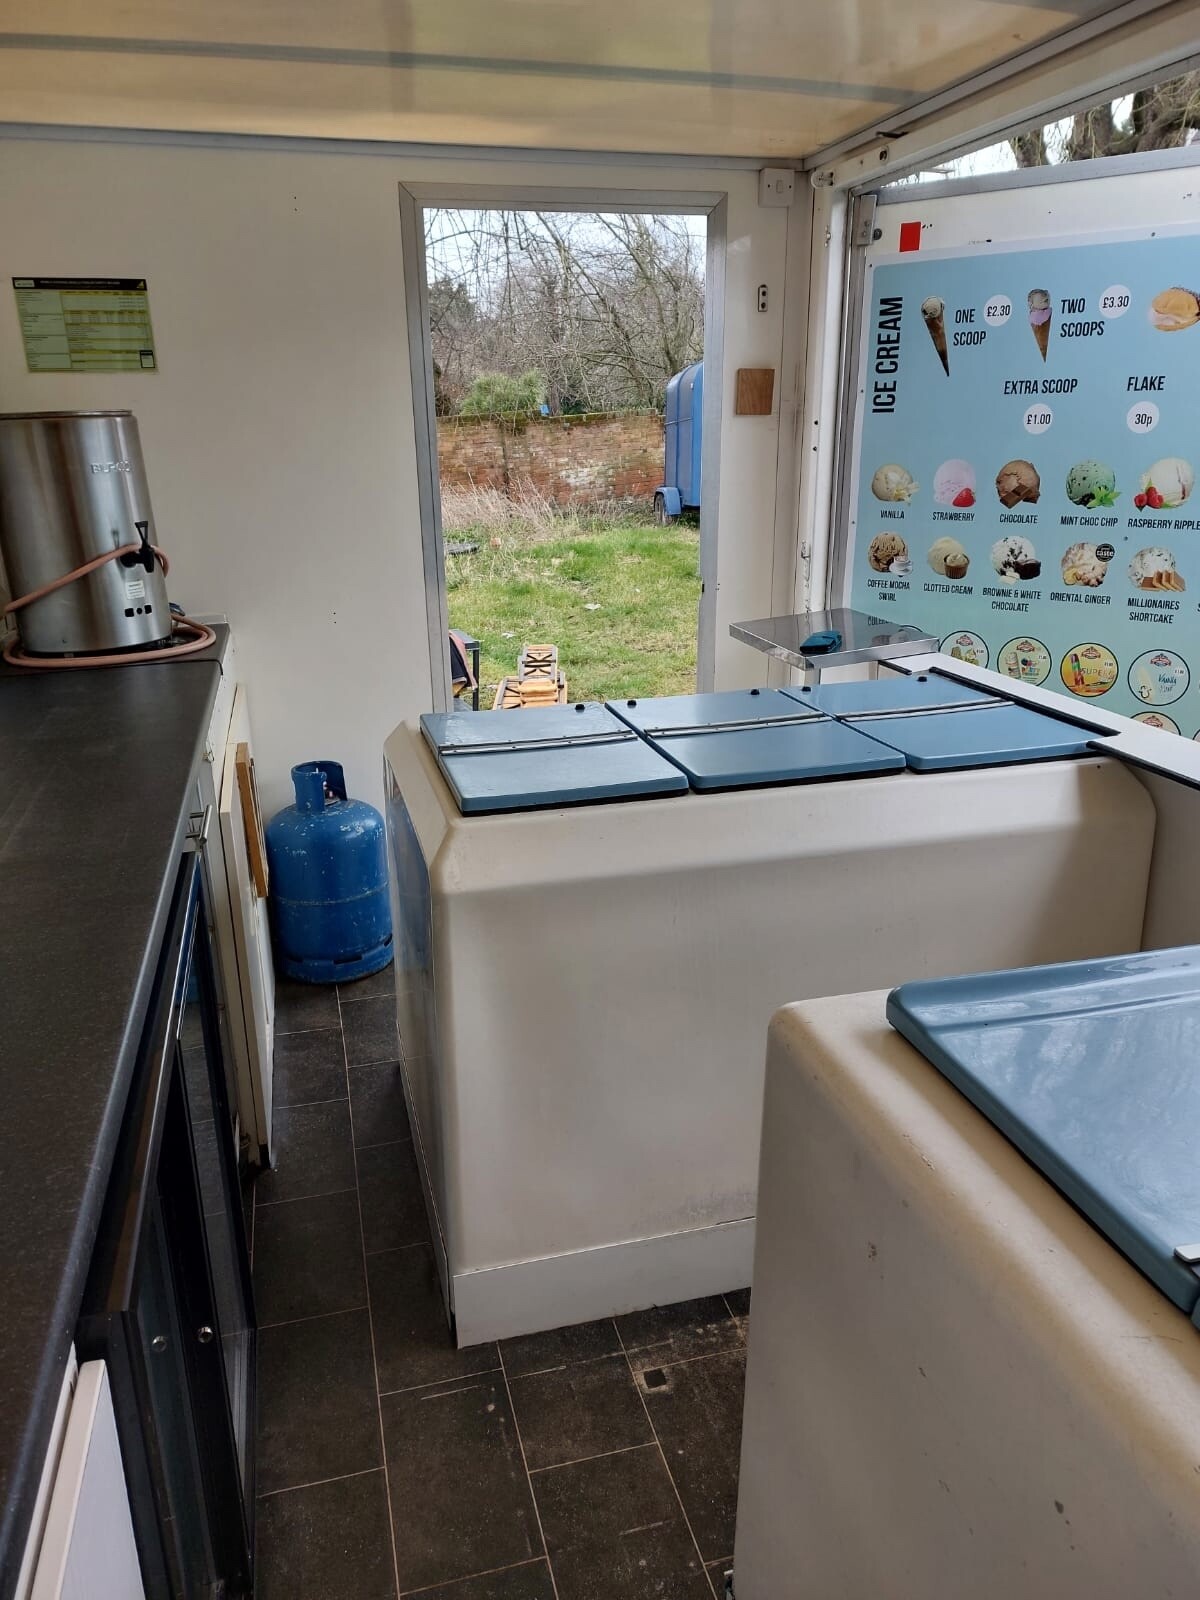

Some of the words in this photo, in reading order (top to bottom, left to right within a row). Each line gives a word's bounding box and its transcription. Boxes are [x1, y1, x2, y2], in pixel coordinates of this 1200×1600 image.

[1060, 297, 1086, 314] TWO
[1101, 295, 1130, 309] £3.30
[955, 309, 975, 324] ONE
[986, 304, 1011, 318] £2.30
[876, 296, 903, 374] CREAM
[1060, 321, 1105, 337] SCOOPS
[952, 331, 987, 346] SCOOP
[1003, 379, 1039, 395] EXTRA
[1041, 378, 1078, 394] SCOOP
[1127, 375, 1166, 392] FLAKE
[872, 379, 896, 413] ICE
[1026, 413, 1051, 426] £1.00
[1134, 412, 1153, 426] 30p
[880, 510, 905, 519] VANILLA
[932, 511, 975, 522] STRAWBERRY
[999, 513, 1039, 525] CHOCOLATE
[1060, 515, 1078, 526] MINT
[1079, 516, 1099, 527] CHOC
[1100, 517, 1118, 528] CHIP
[1127, 518, 1173, 530] RASPBERRY
[1174, 520, 1200, 532] RIPPLE
[867, 578, 889, 589] COFFEE
[890, 580, 910, 590] MOCHA
[923, 583, 950, 593] CLOTTED
[951, 585, 973, 595] CREAM
[878, 592, 897, 602] SWIRL
[982, 587, 1012, 598] BROWNIE
[1014, 588, 1019, 598] &
[1020, 589, 1041, 600] WHITE
[1050, 592, 1083, 603] ORIENTAL
[1084, 594, 1111, 605] GINGER
[991, 600, 1029, 613] CHOCOLATE
[1127, 598, 1180, 610] MILLIONAIRES
[1129, 612, 1174, 624] SHORTCAKE
